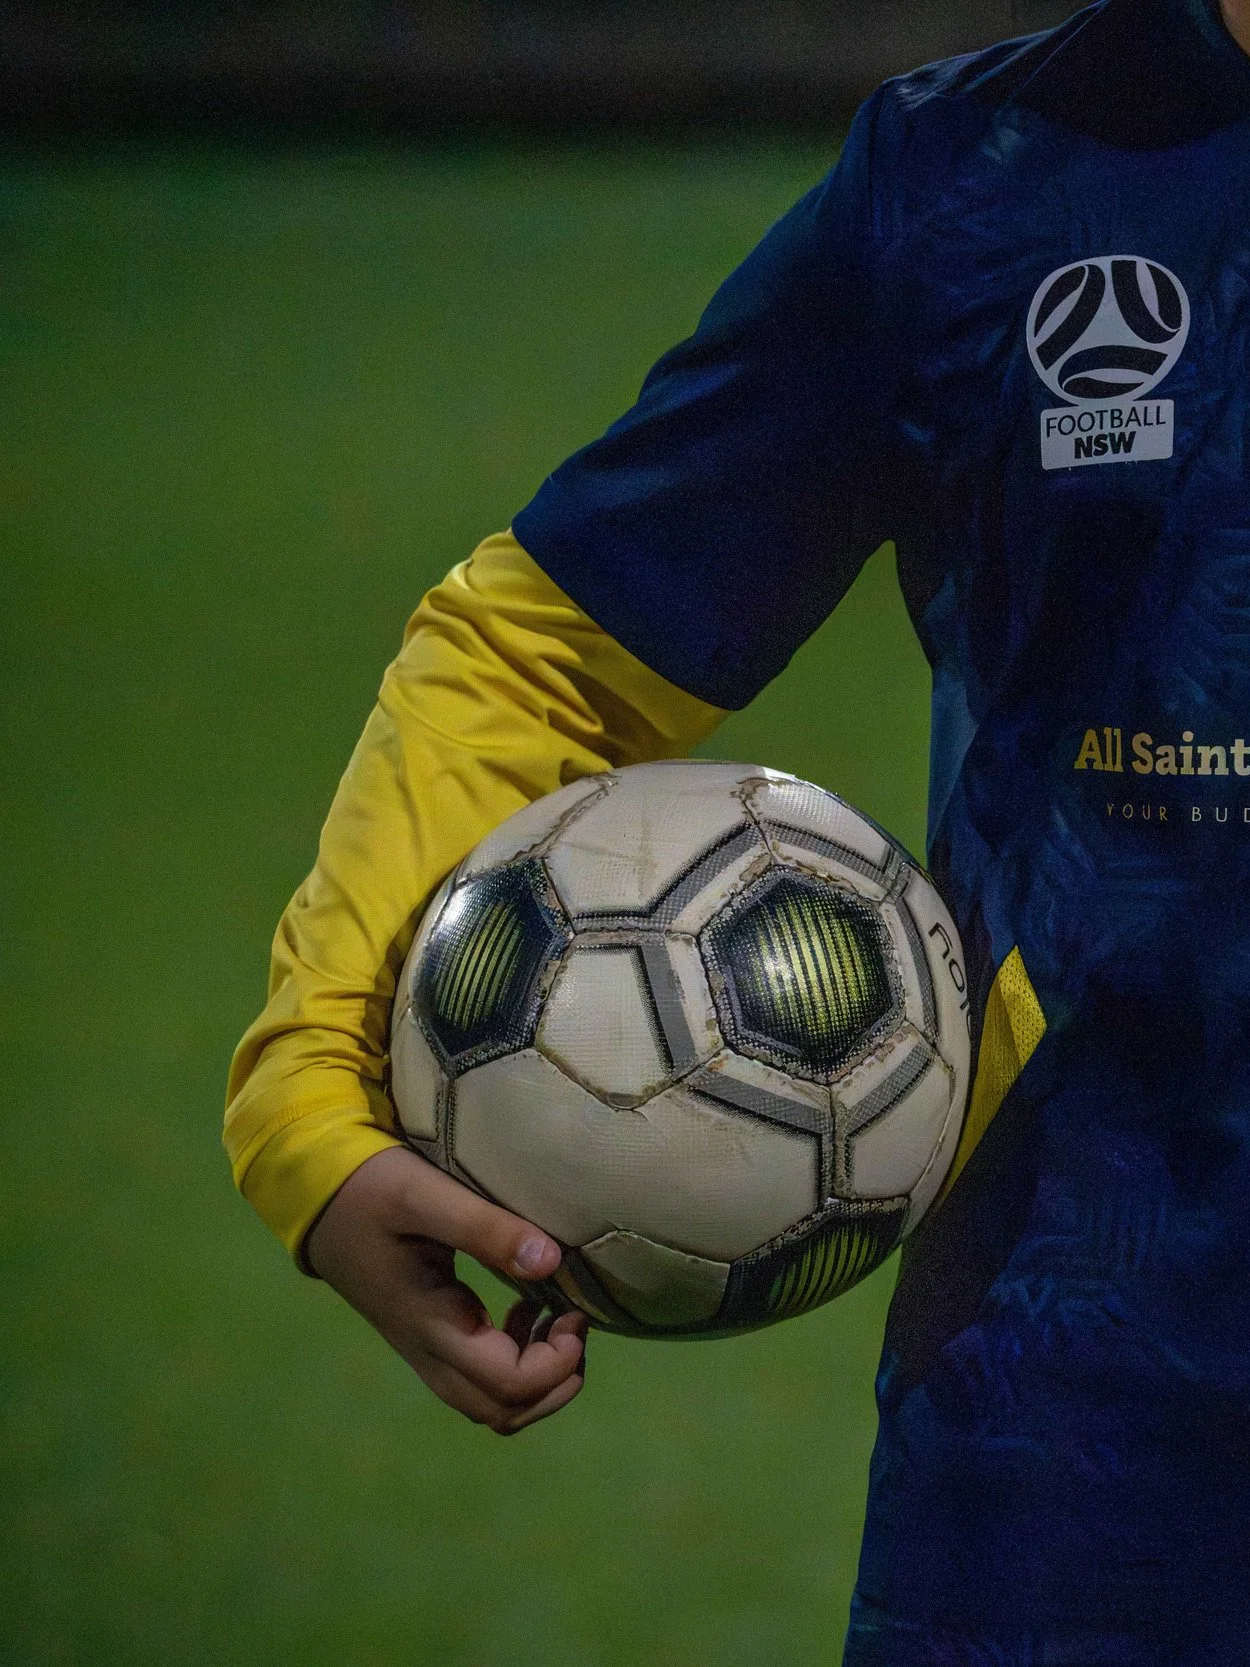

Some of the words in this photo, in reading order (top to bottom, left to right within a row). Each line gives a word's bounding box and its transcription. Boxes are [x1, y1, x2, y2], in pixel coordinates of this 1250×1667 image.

[1046, 405, 1166, 438] FOOTBALL
[1074, 431, 1136, 459] NSW
[1074, 727, 1124, 773] All
[1106, 803, 1168, 821] YOUR
